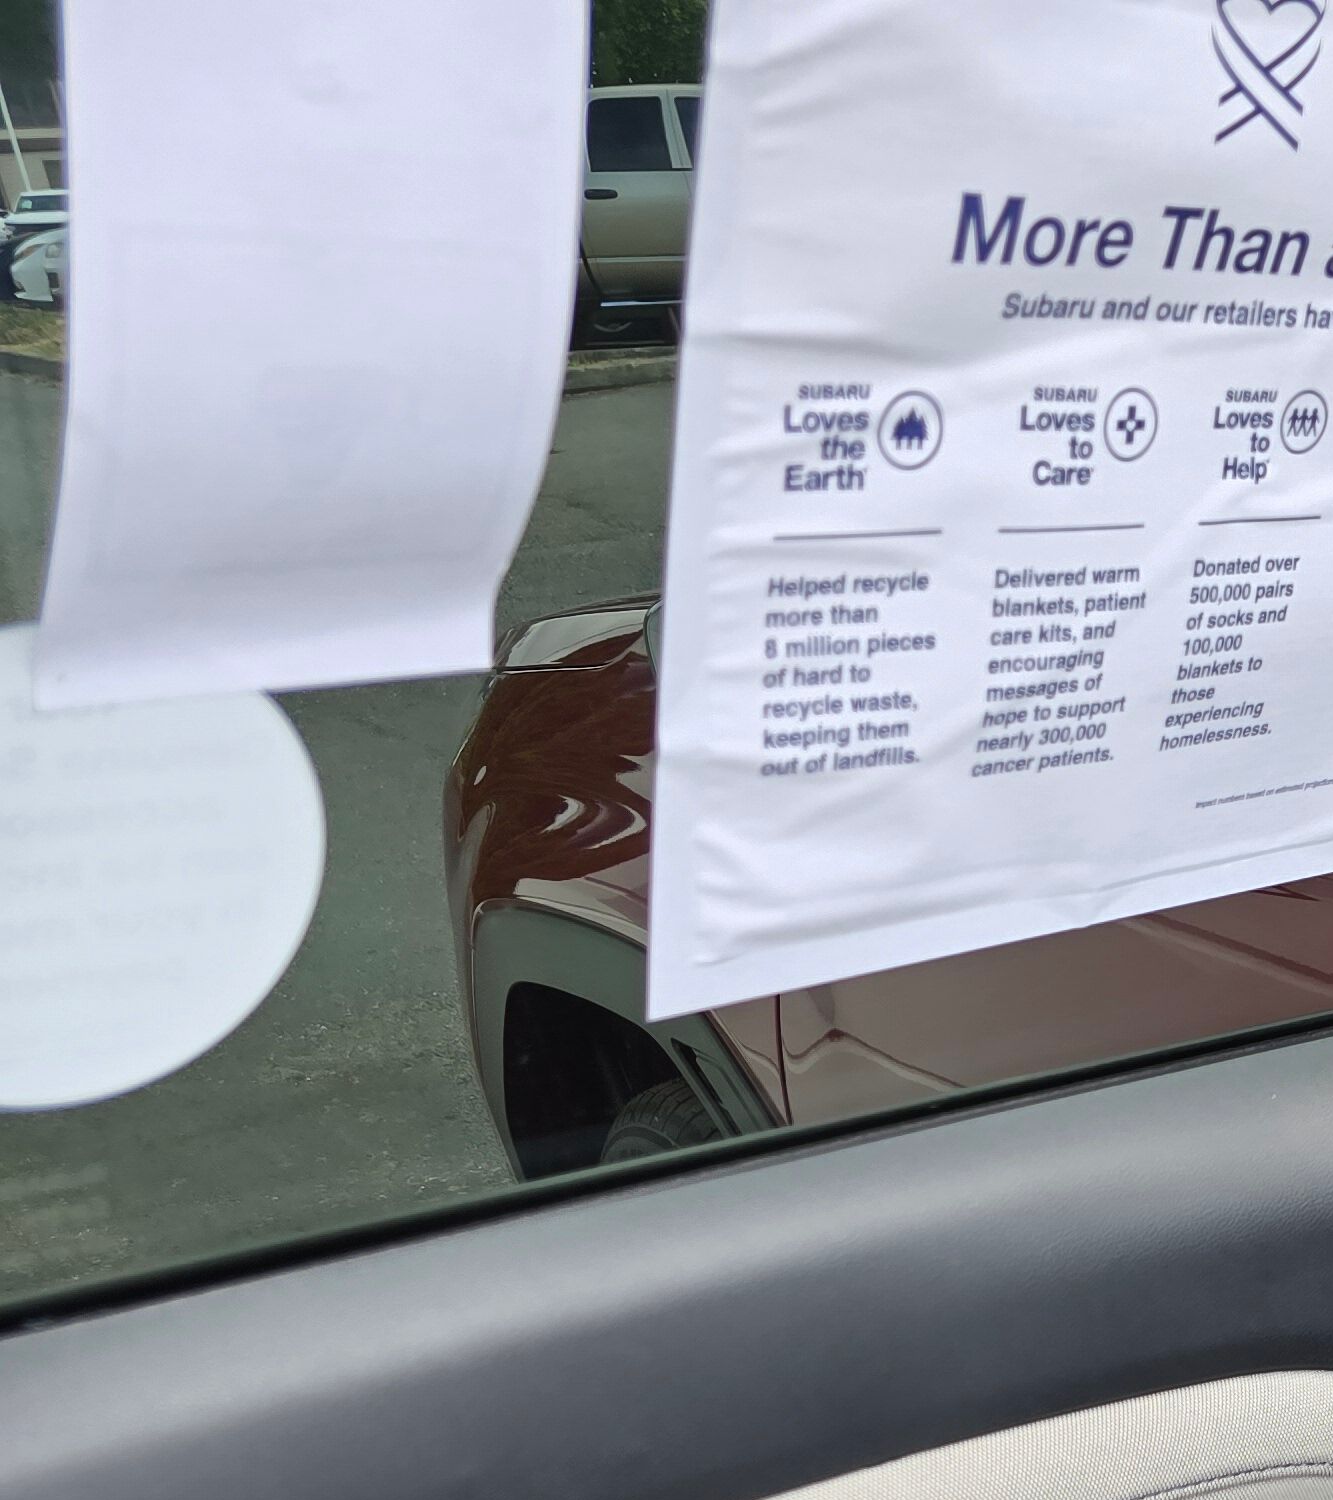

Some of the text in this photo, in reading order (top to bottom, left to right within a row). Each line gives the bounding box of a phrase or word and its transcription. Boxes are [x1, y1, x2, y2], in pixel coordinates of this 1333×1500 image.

[951, 192, 1134, 268] More
[1163, 205, 1311, 276] Than
[1002, 292, 1095, 320] Subaru
[1102, 295, 1151, 322] and
[1156, 301, 1198, 323] our
[1203, 301, 1297, 329] retailers
[798, 384, 870, 400] SUBARU
[1033, 386, 1097, 402] SUBARU
[1226, 390, 1278, 402] SUBARU
[784, 405, 869, 433] Loves
[1020, 405, 1095, 431] Loves
[1213, 406, 1274, 429] Loves
[821, 435, 865, 460] the
[1069, 436, 1093, 459] to
[1250, 432, 1270, 453] to
[784, 464, 864, 492] Earth
[1033, 460, 1091, 486] Care
[1222, 456, 1267, 484] Help
[994, 566, 1140, 588] Delivered warm
[1193, 556, 1300, 577] Donated over
[768, 571, 929, 600] Helped recycle
[1189, 581, 1293, 604] 500,000 pairs
[765, 604, 878, 628] more than
[992, 592, 1147, 617] blankets, patient
[1186, 606, 1287, 630] of socks and
[785, 636, 859, 658] million
[867, 633, 936, 657] pieces
[990, 620, 1116, 646] care kits, and
[1183, 634, 1243, 656] 100,000
[988, 650, 1104, 674] encouraging
[1176, 657, 1262, 681] blankets to
[763, 665, 871, 688] of hard to
[986, 673, 1103, 701] messages of
[763, 692, 917, 721] recycle waste,
[1170, 687, 1215, 704] those
[982, 697, 1126, 728] hope to support
[1164, 701, 1264, 728] experiencing
[764, 721, 909, 750] keeping them
[976, 722, 1107, 752] nearly 300,000
[1159, 722, 1272, 751] homelessness.
[760, 747, 919, 777] out of landfills.
[971, 748, 1114, 777] cancer patients.
